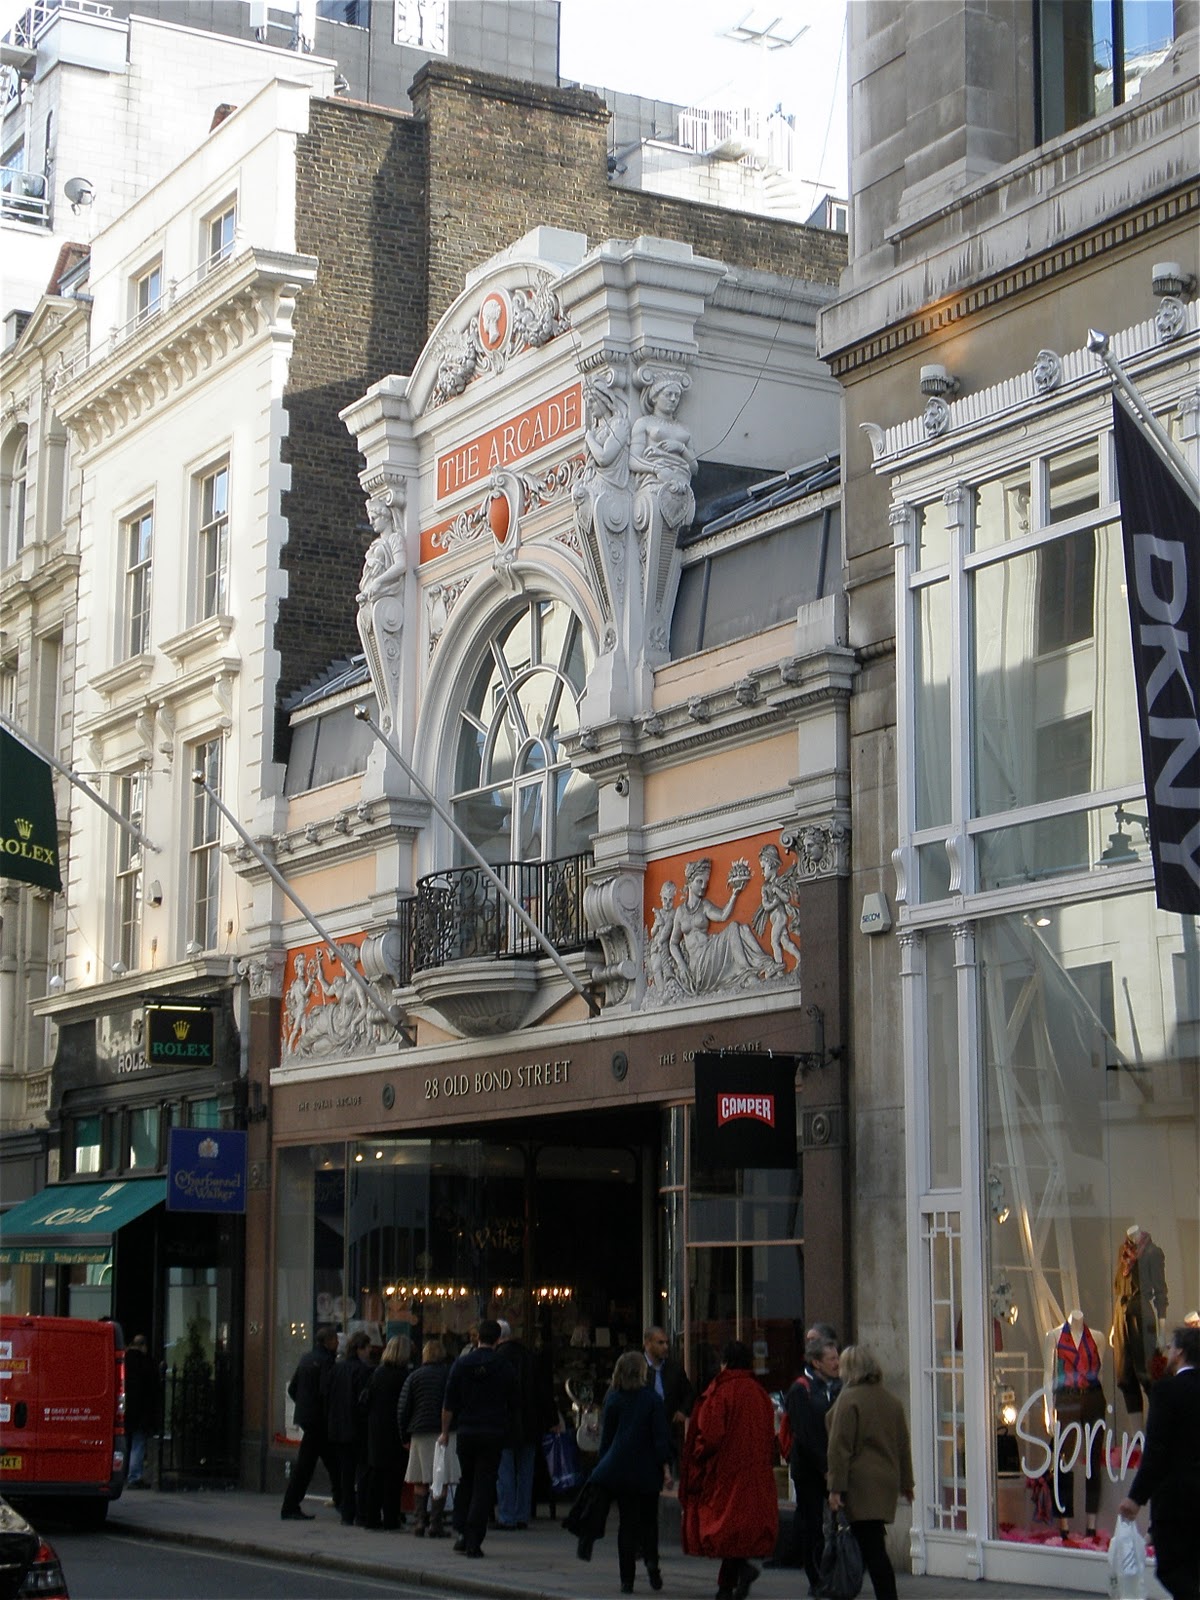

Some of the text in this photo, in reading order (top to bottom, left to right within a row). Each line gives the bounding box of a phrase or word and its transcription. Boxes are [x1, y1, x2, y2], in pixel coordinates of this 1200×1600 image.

[441, 391, 577, 492] THE ARCADE
[1133, 533, 1200, 888] DKNY
[118, 1051, 152, 1073] ROLE
[152, 1042, 210, 1056] ROLEX
[659, 1053, 676, 1066] THE
[424, 1060, 571, 1099] 28 OLD BOND STREET
[721, 1097, 771, 1120] CAMPER
[1015, 1388, 1145, 1513] Sprin
